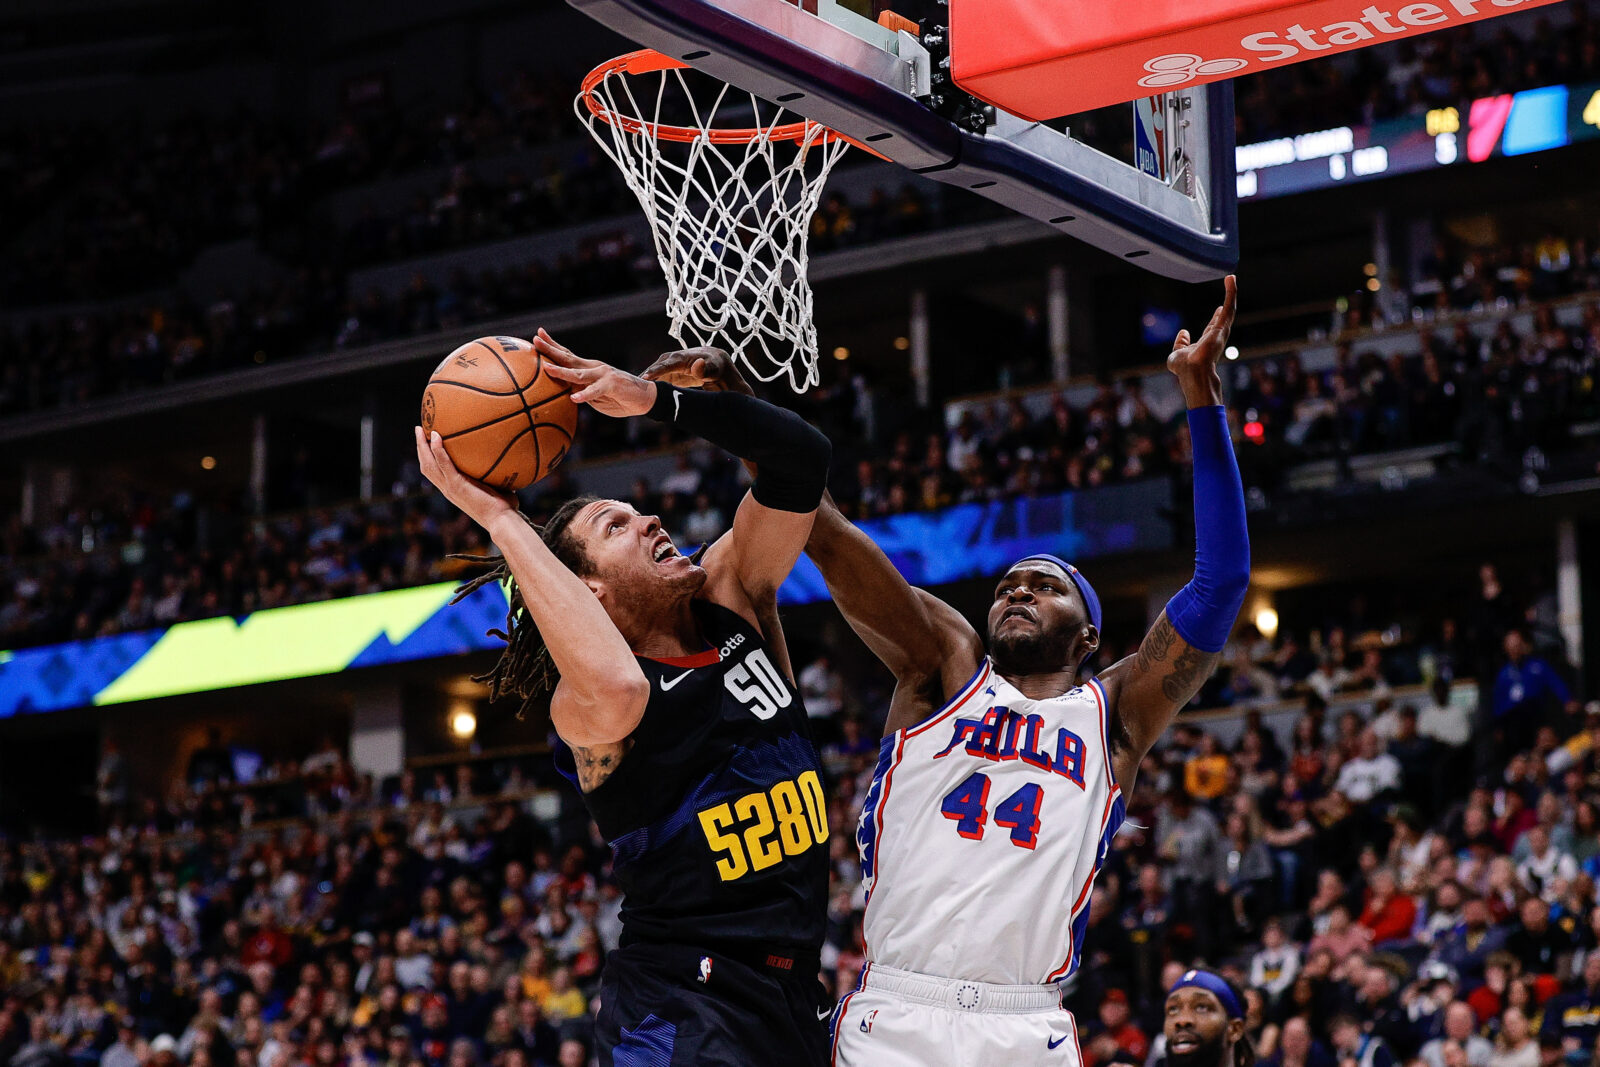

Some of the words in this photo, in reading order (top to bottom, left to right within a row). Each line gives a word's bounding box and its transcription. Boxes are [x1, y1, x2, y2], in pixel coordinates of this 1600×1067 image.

[1241, 2, 1449, 62] State
[1139, 147, 1155, 174] NBA
[723, 648, 792, 721] 50
[933, 705, 1087, 792] PHILA
[697, 770, 830, 882] 5280
[940, 771, 1045, 851] 44
